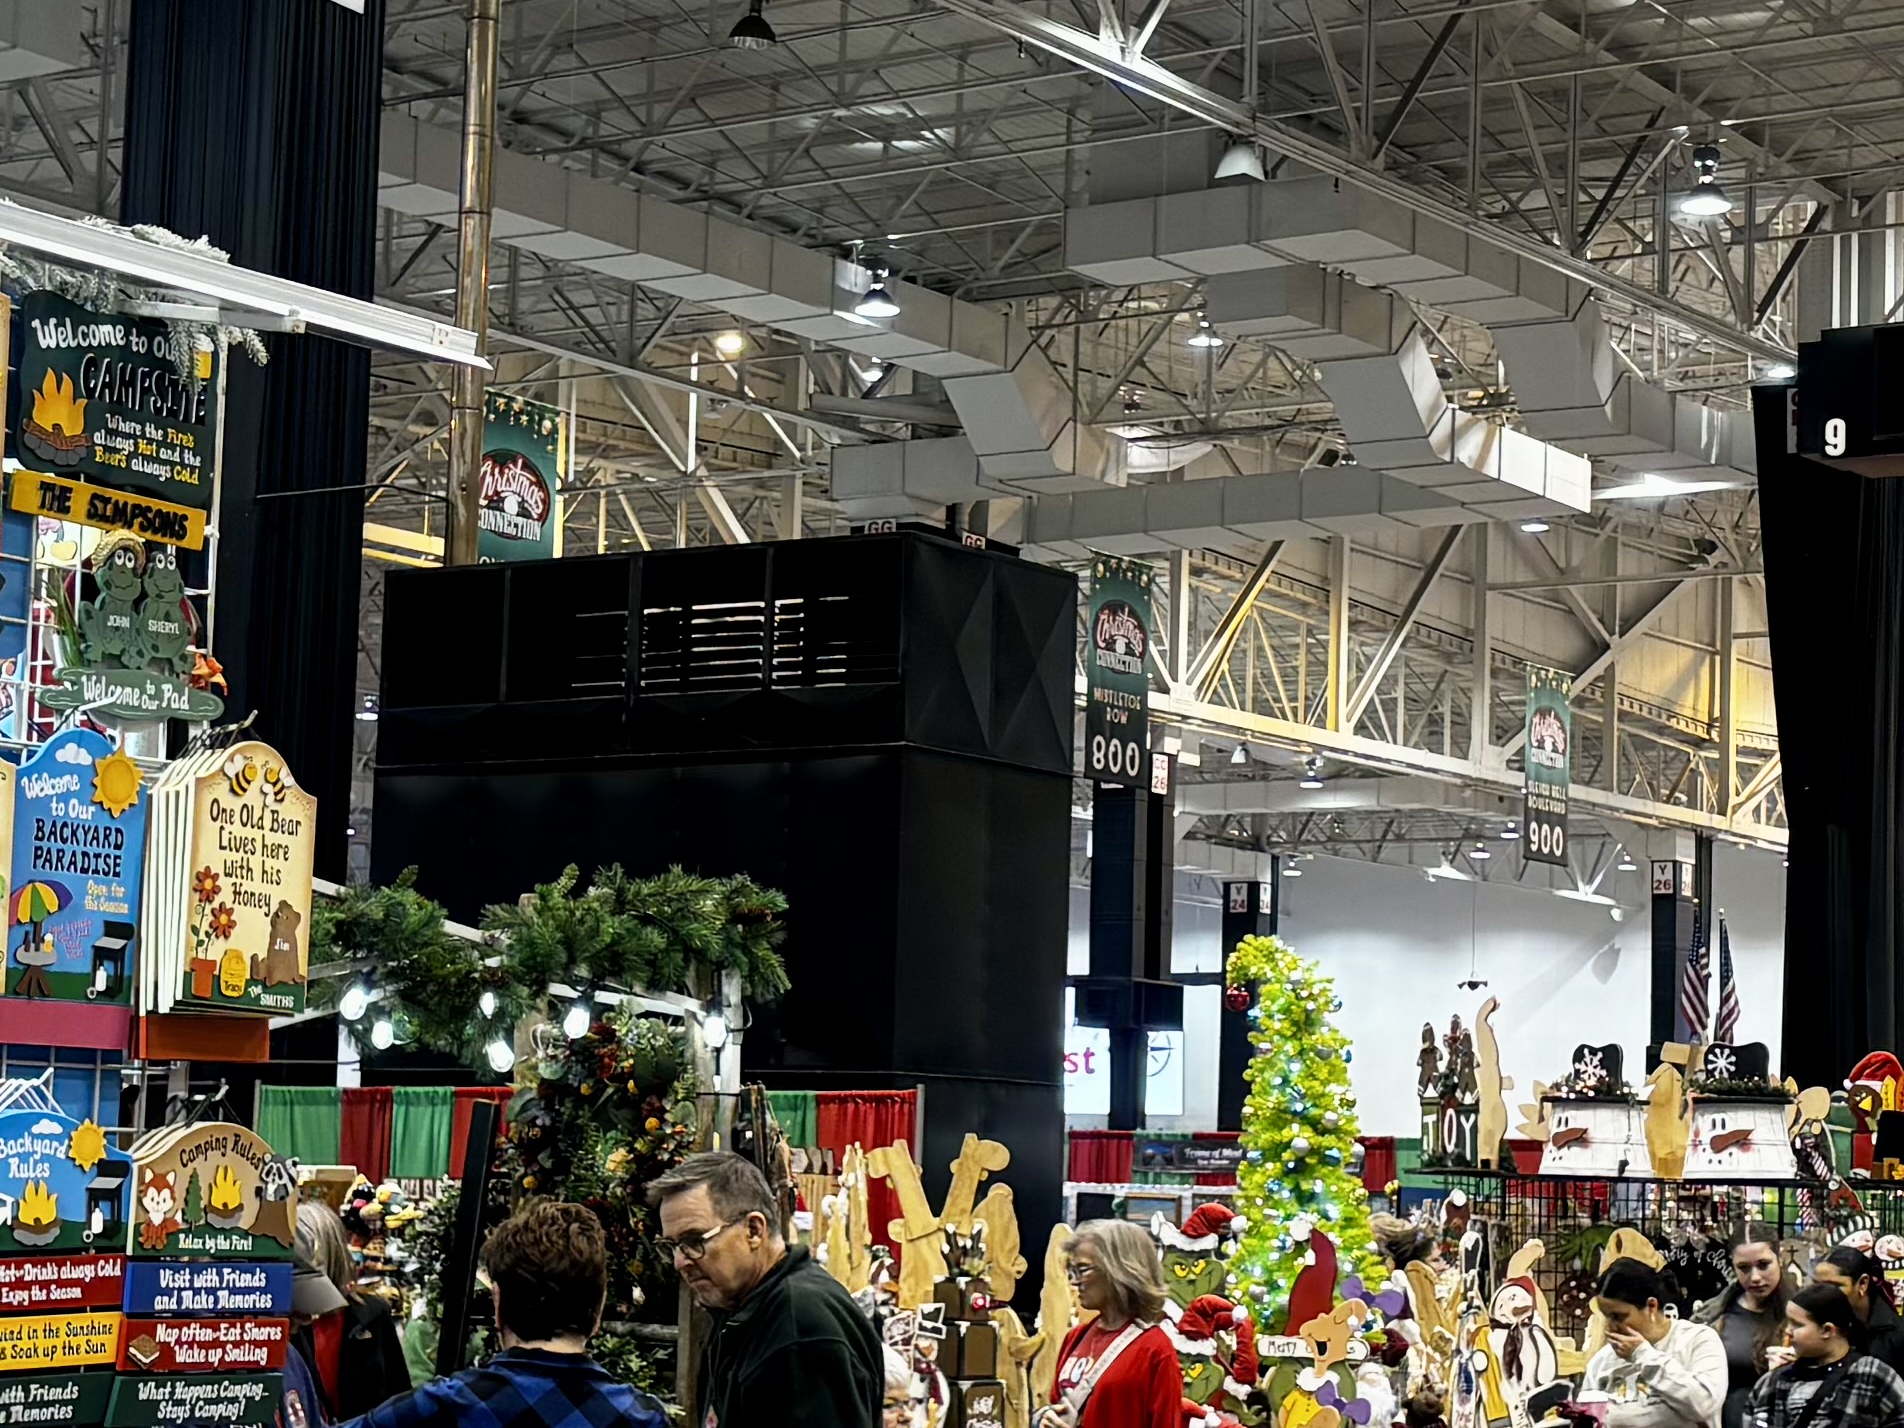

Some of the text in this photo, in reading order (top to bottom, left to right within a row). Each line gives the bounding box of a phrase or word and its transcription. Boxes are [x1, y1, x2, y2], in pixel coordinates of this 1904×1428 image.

[1825, 418, 1846, 456] 9
[38, 481, 188, 542] THE SIMPSONS
[107, 614, 132, 630] JOHN
[147, 618, 180, 636] SHERYL
[1107, 707, 1129, 725] ROW
[1093, 735, 1139, 777] 800
[1154, 775, 1166, 790] 26
[33, 817, 124, 852] BACKYARD
[1530, 821, 1563, 857] 900
[32, 844, 122, 877] PARADISE
[1658, 864, 1667, 875] Y
[1654, 879, 1671, 890] 26
[180, 1132, 262, 1170] Camping Rules
[1422, 1109, 1477, 1161] JOY
[159, 1269, 267, 1292] Visit with Friends
